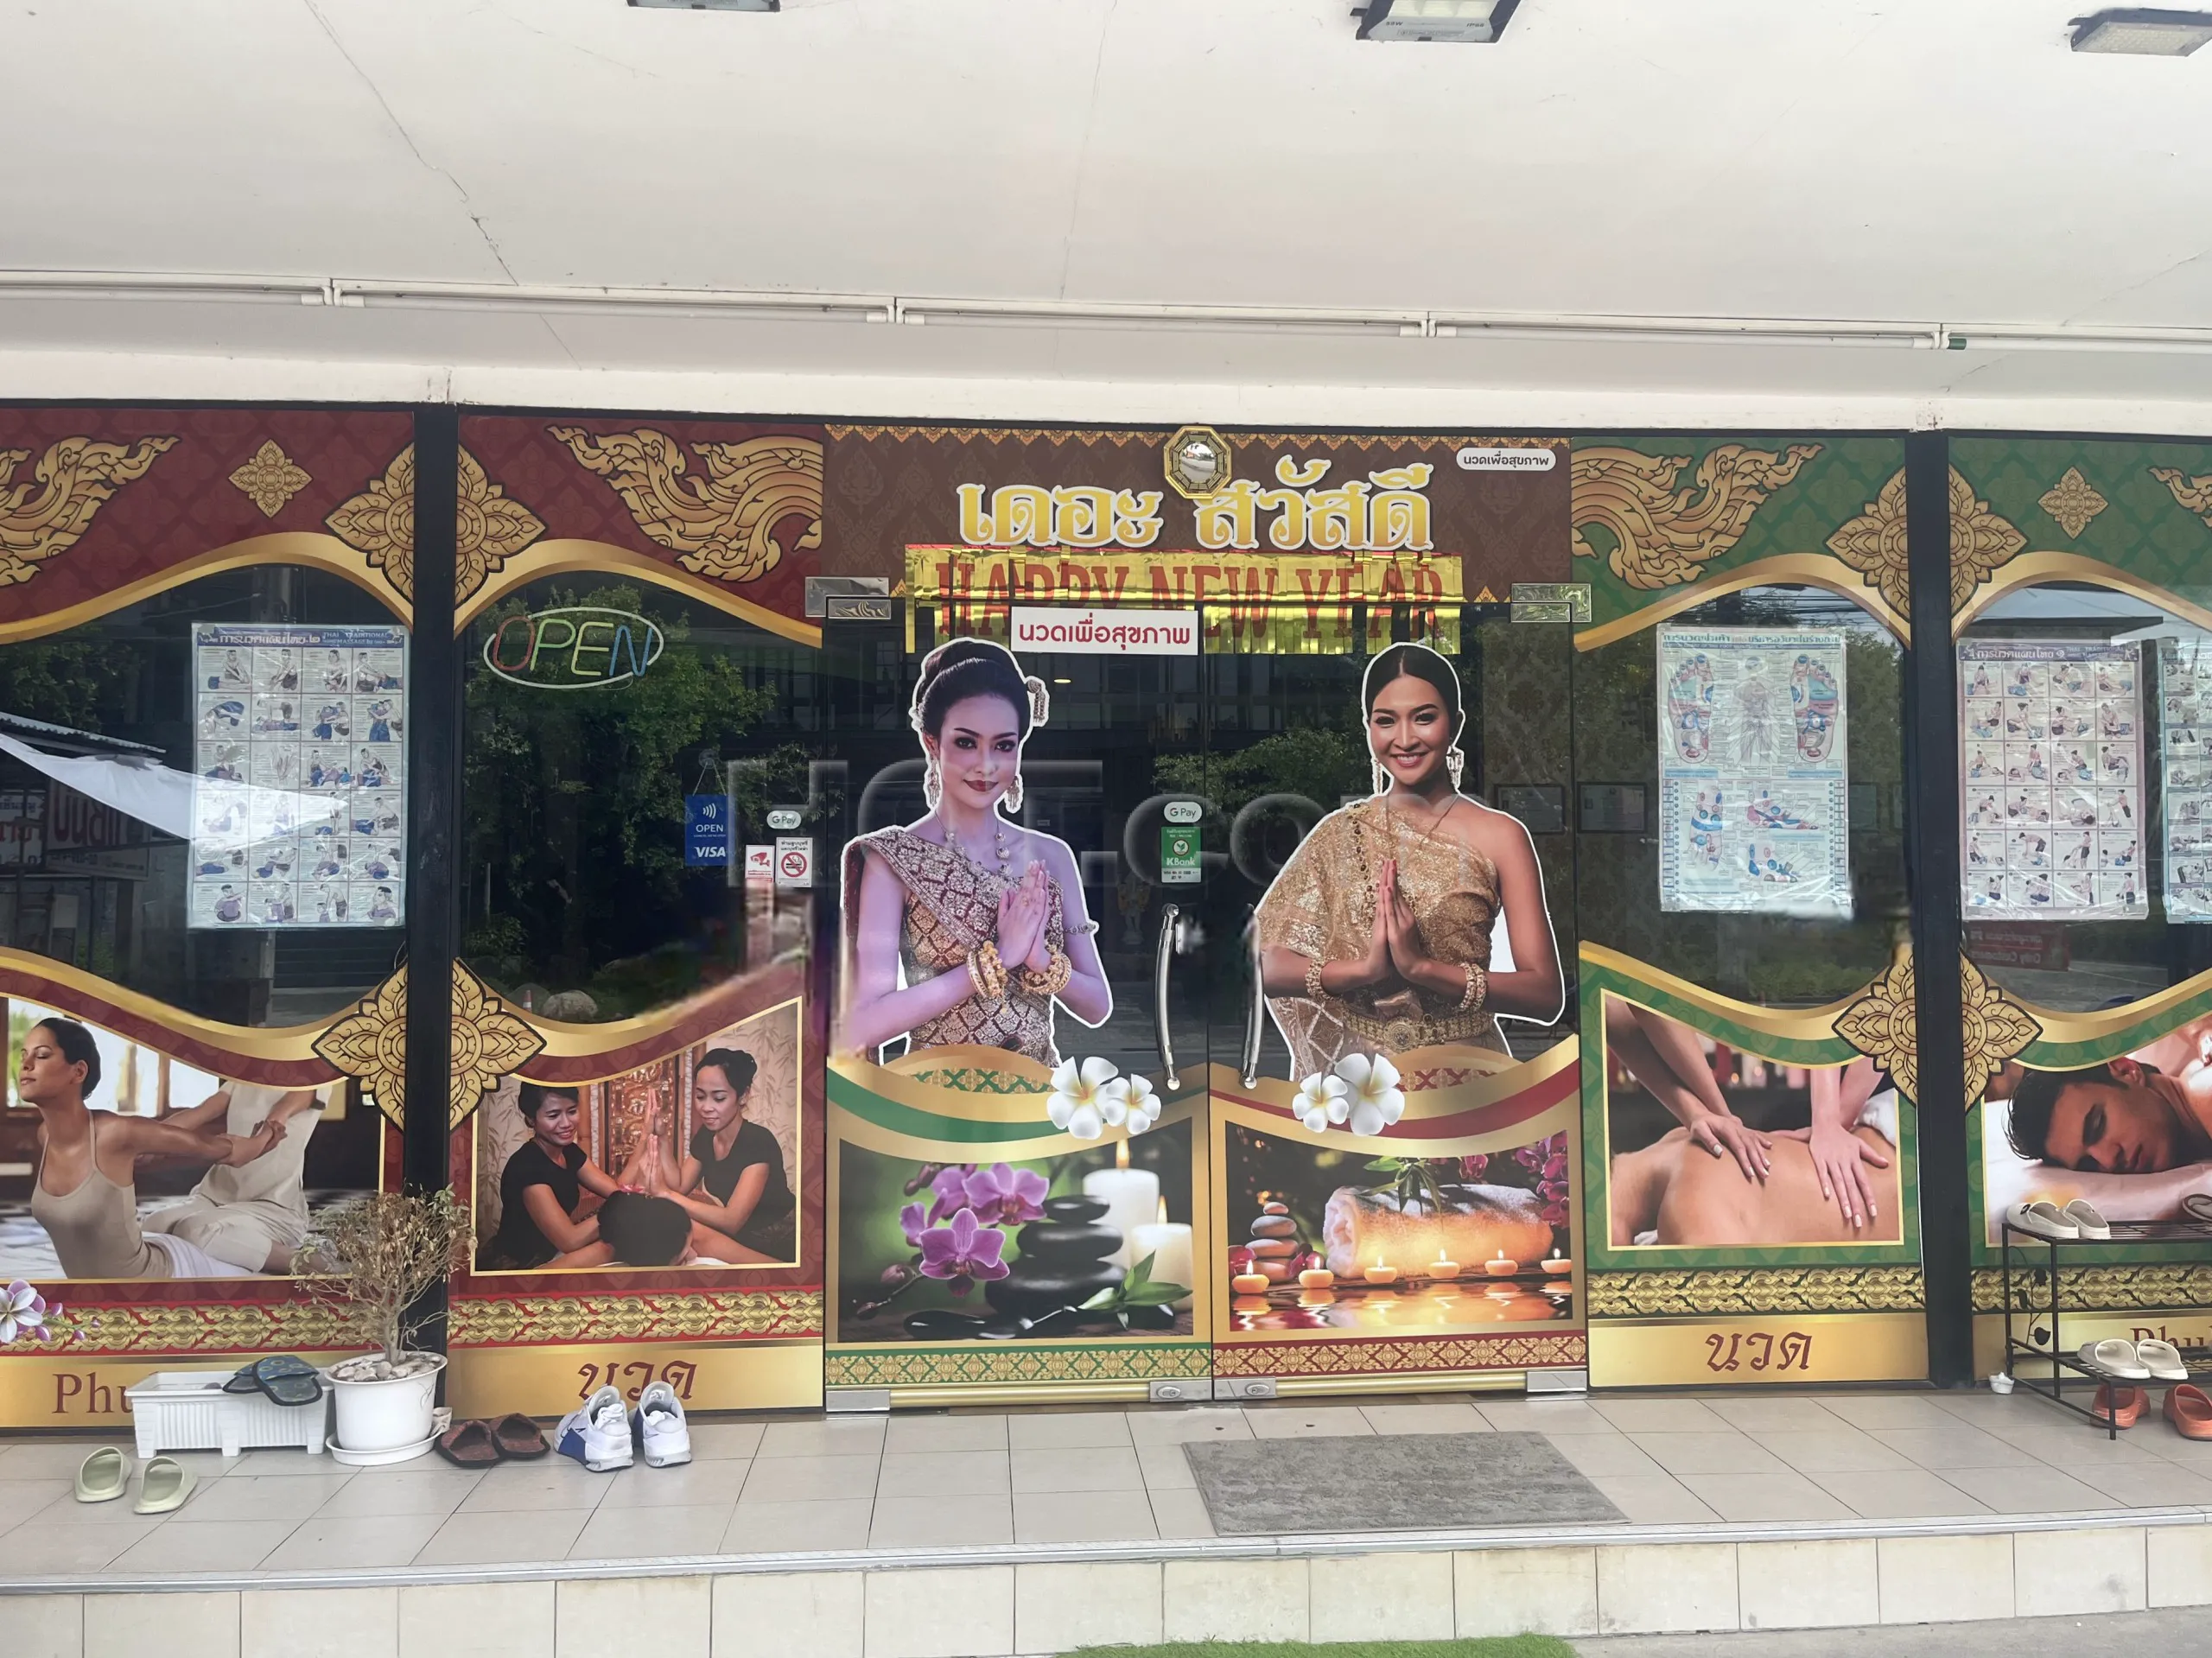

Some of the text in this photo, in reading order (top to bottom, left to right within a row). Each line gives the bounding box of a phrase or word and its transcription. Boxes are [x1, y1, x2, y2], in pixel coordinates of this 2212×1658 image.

[1464, 451, 1549, 468] นวดเพื่อสุขภาพ
[957, 454, 1434, 551] เดอะ สวัสดี
[1149, 565, 1276, 639] NEW
[1020, 612, 1191, 651] นวดเพื่อสุขภาพ
[493, 616, 653, 677] OPEN
[782, 816, 797, 826] Pay
[1180, 808, 1197, 819] Pay
[696, 824, 724, 833] OPEN
[694, 847, 727, 858] VISA
[1166, 856, 1196, 866] KBank
[1705, 1331, 1813, 1372] นวด
